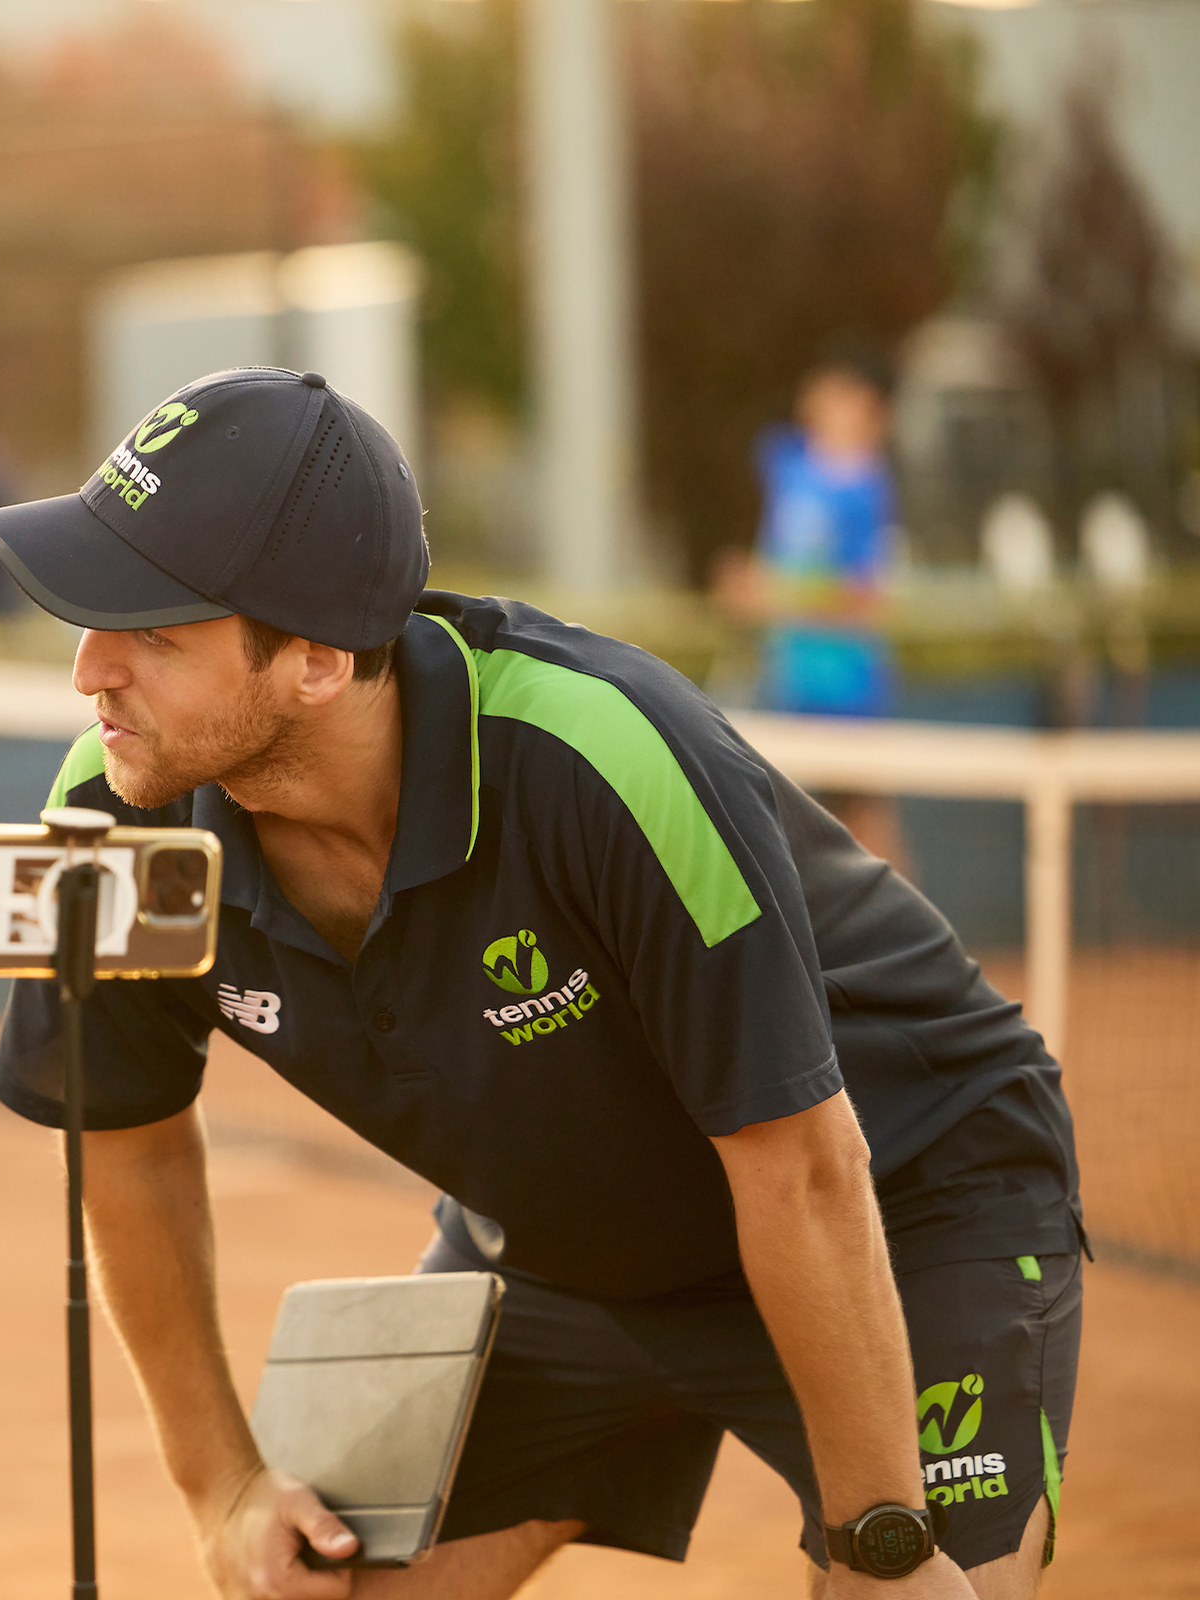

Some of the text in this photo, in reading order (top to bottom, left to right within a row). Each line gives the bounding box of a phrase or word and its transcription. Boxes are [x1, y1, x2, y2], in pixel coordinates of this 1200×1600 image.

[112, 444, 162, 495] ennis
[482, 967, 590, 1028] tennis
[499, 982, 601, 1047] world
[920, 1452, 1007, 1485] nnis
[924, 1473, 1009, 1507] orld
